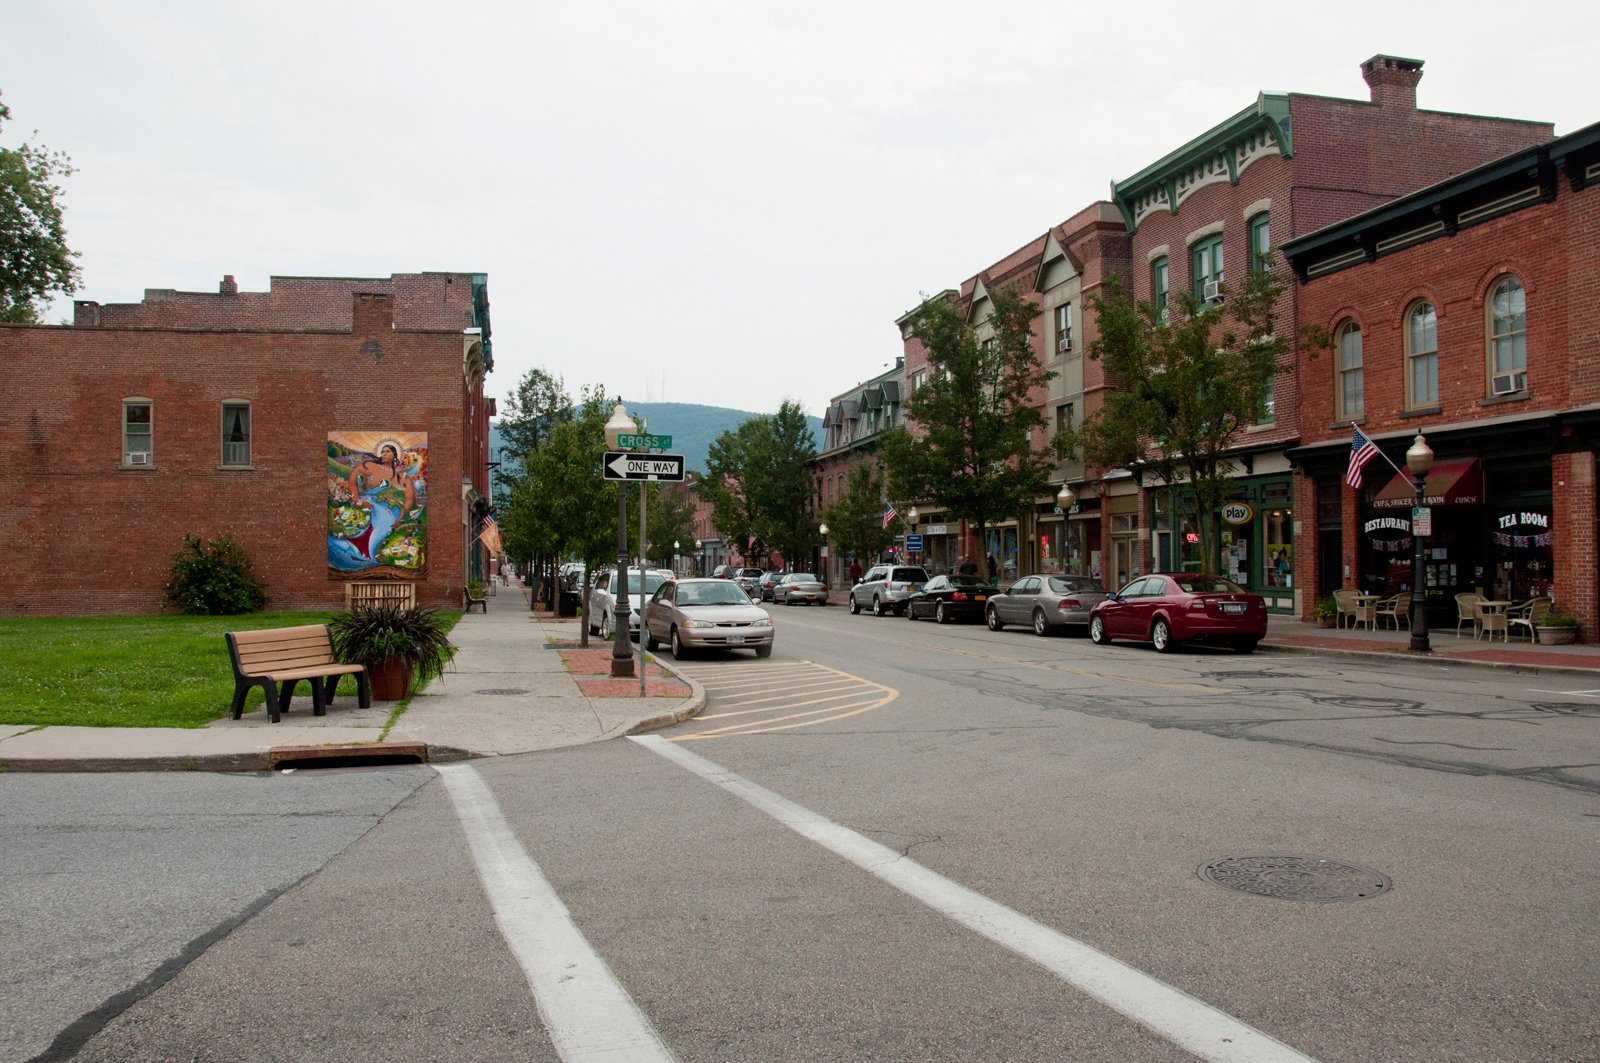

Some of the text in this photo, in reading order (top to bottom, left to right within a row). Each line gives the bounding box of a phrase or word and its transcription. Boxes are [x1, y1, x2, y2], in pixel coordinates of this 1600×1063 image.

[620, 435, 659, 447] CROSS
[627, 461, 675, 473] ONE WAY
[1426, 496, 1445, 505] ROOM
[1226, 507, 1246, 521] play
[1499, 512, 1548, 529] TEA ROOM
[1364, 517, 1411, 534] RESTAURANT
